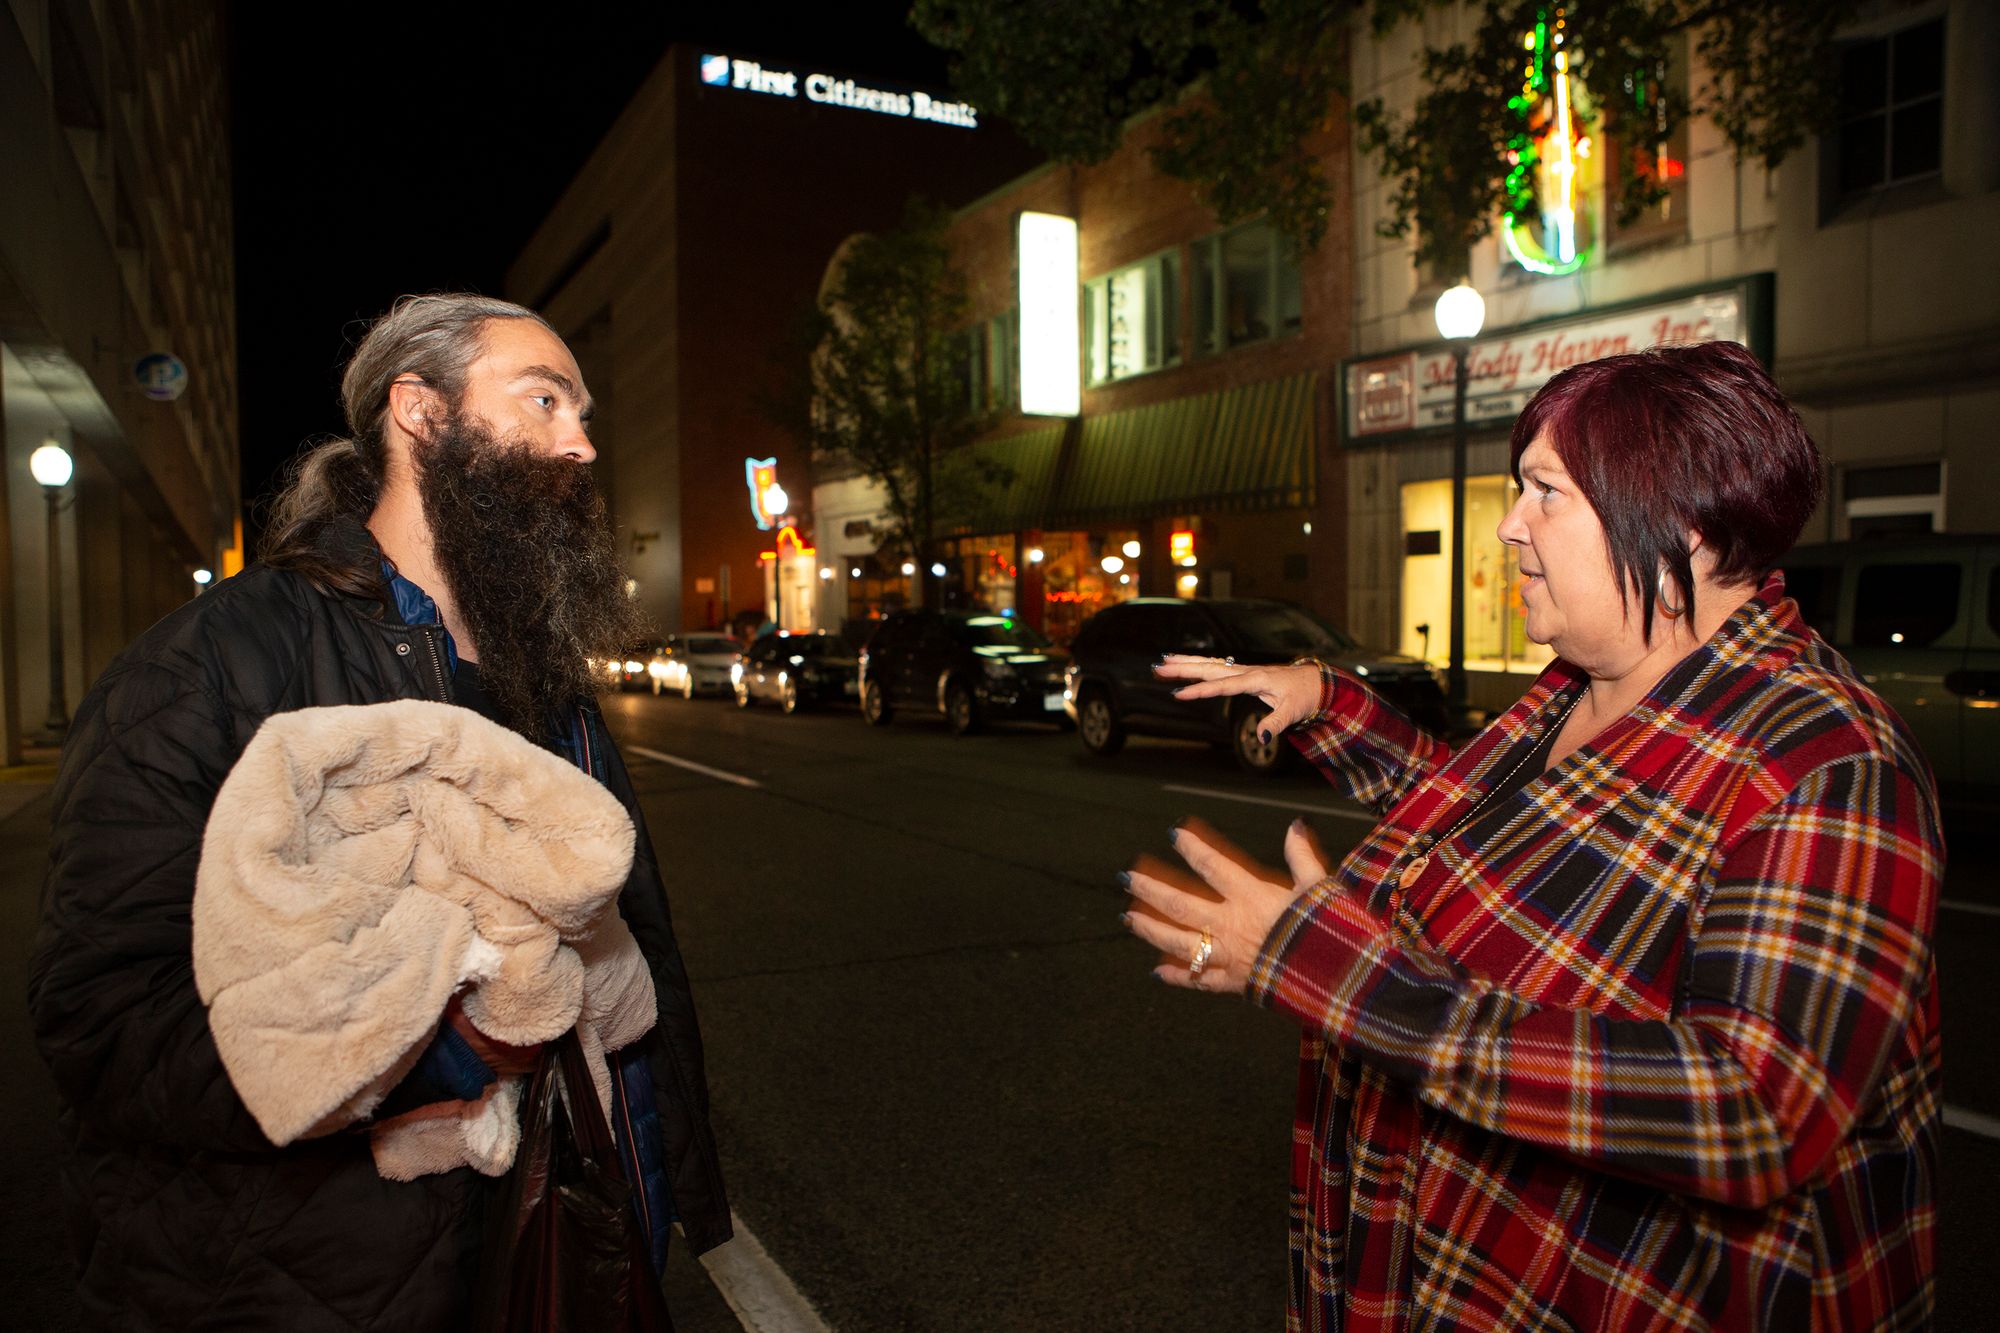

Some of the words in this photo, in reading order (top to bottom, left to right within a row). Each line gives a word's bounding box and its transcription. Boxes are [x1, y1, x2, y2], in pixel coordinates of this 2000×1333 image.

[731, 59, 797, 97] First
[804, 73, 911, 116] Citizens
[911, 91, 977, 128] Bank
[1423, 340, 1522, 389] Mlody
